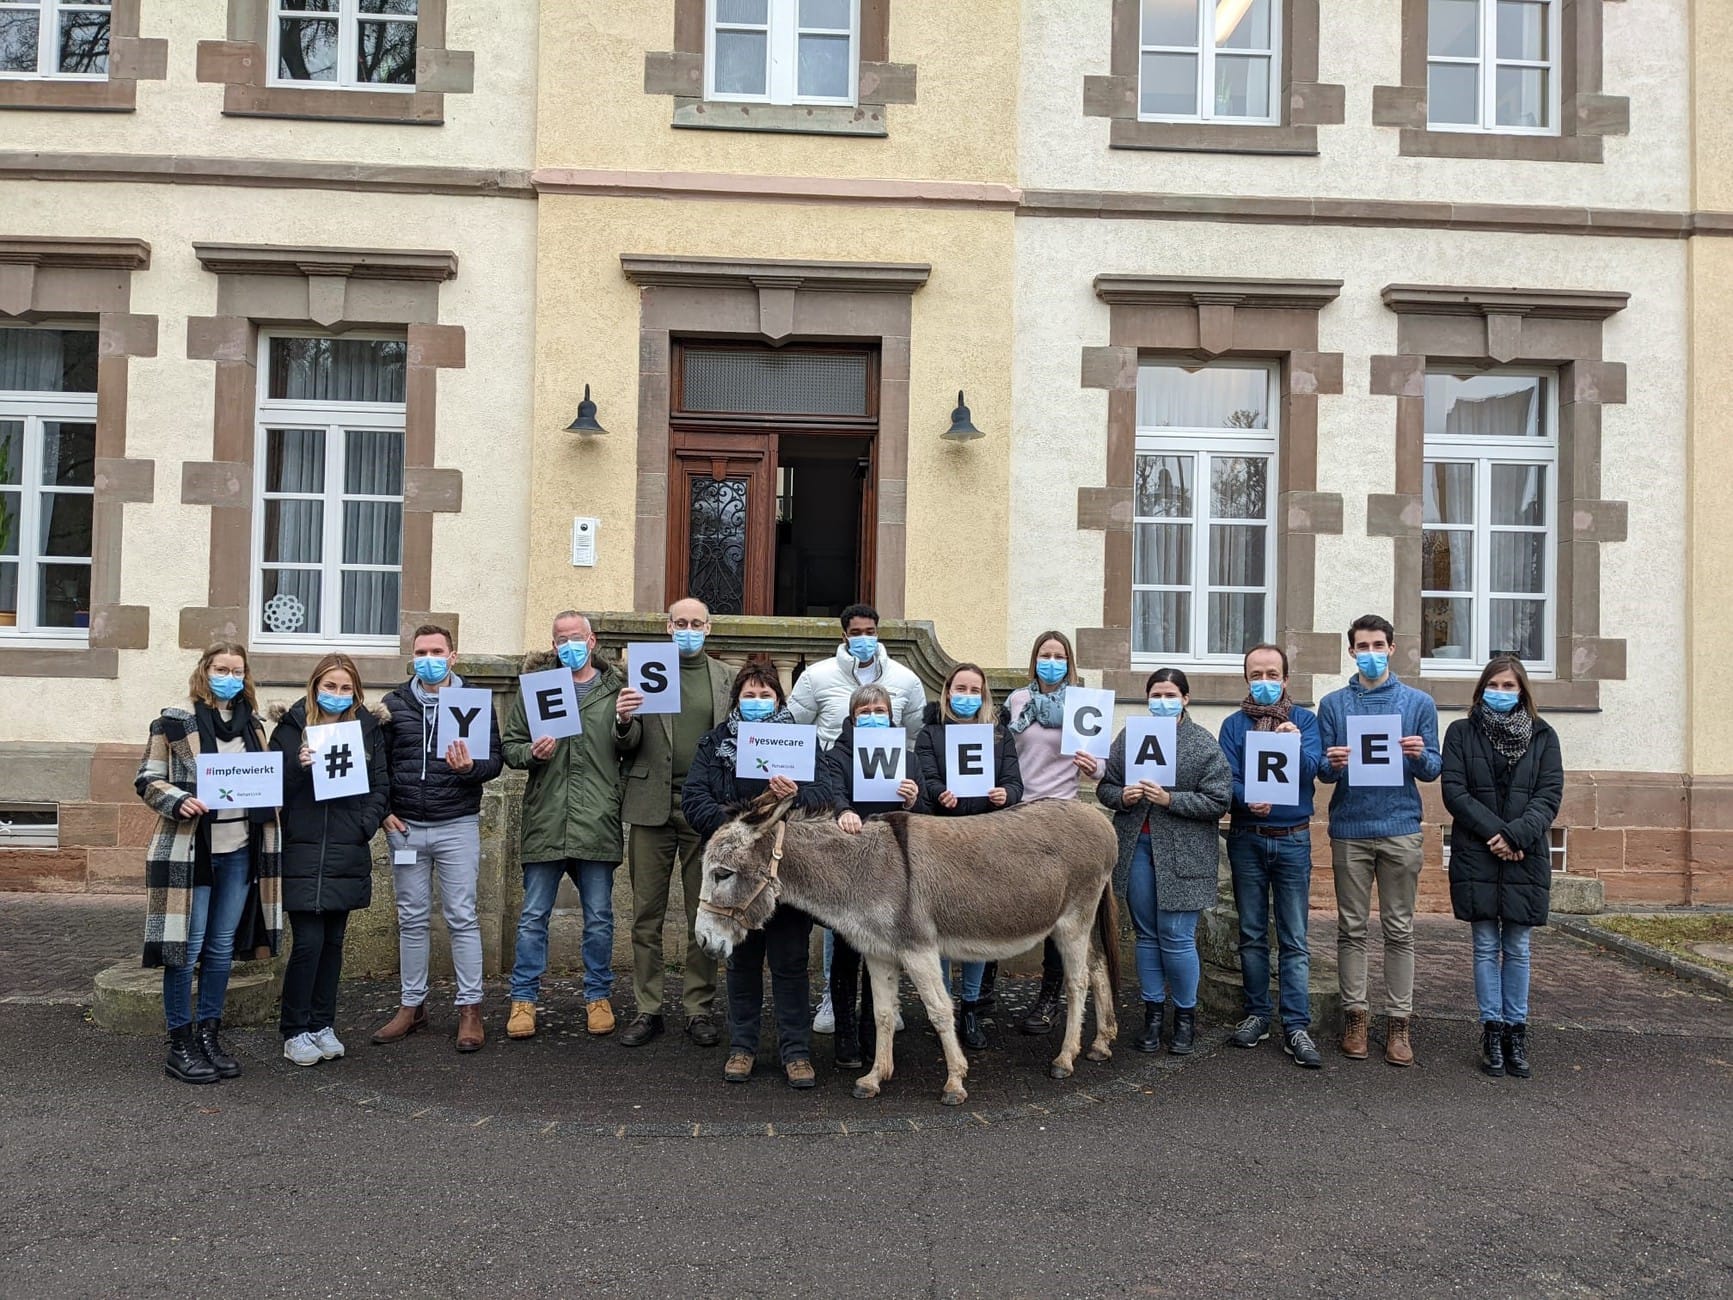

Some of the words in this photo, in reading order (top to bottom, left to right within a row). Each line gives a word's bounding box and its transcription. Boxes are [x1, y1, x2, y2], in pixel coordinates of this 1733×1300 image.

[640, 662, 668, 694] S
[536, 688, 568, 721] E
[449, 707, 481, 739] Y
[1073, 706, 1103, 737] C
[749, 736, 804, 747] #yeswecare
[1134, 735, 1168, 766] A
[1361, 734, 1390, 765] E
[206, 765, 274, 777] #impfewierkt
[324, 744, 353, 779] #
[858, 747, 902, 780] W
[957, 743, 984, 776] E
[1257, 751, 1290, 783] R
